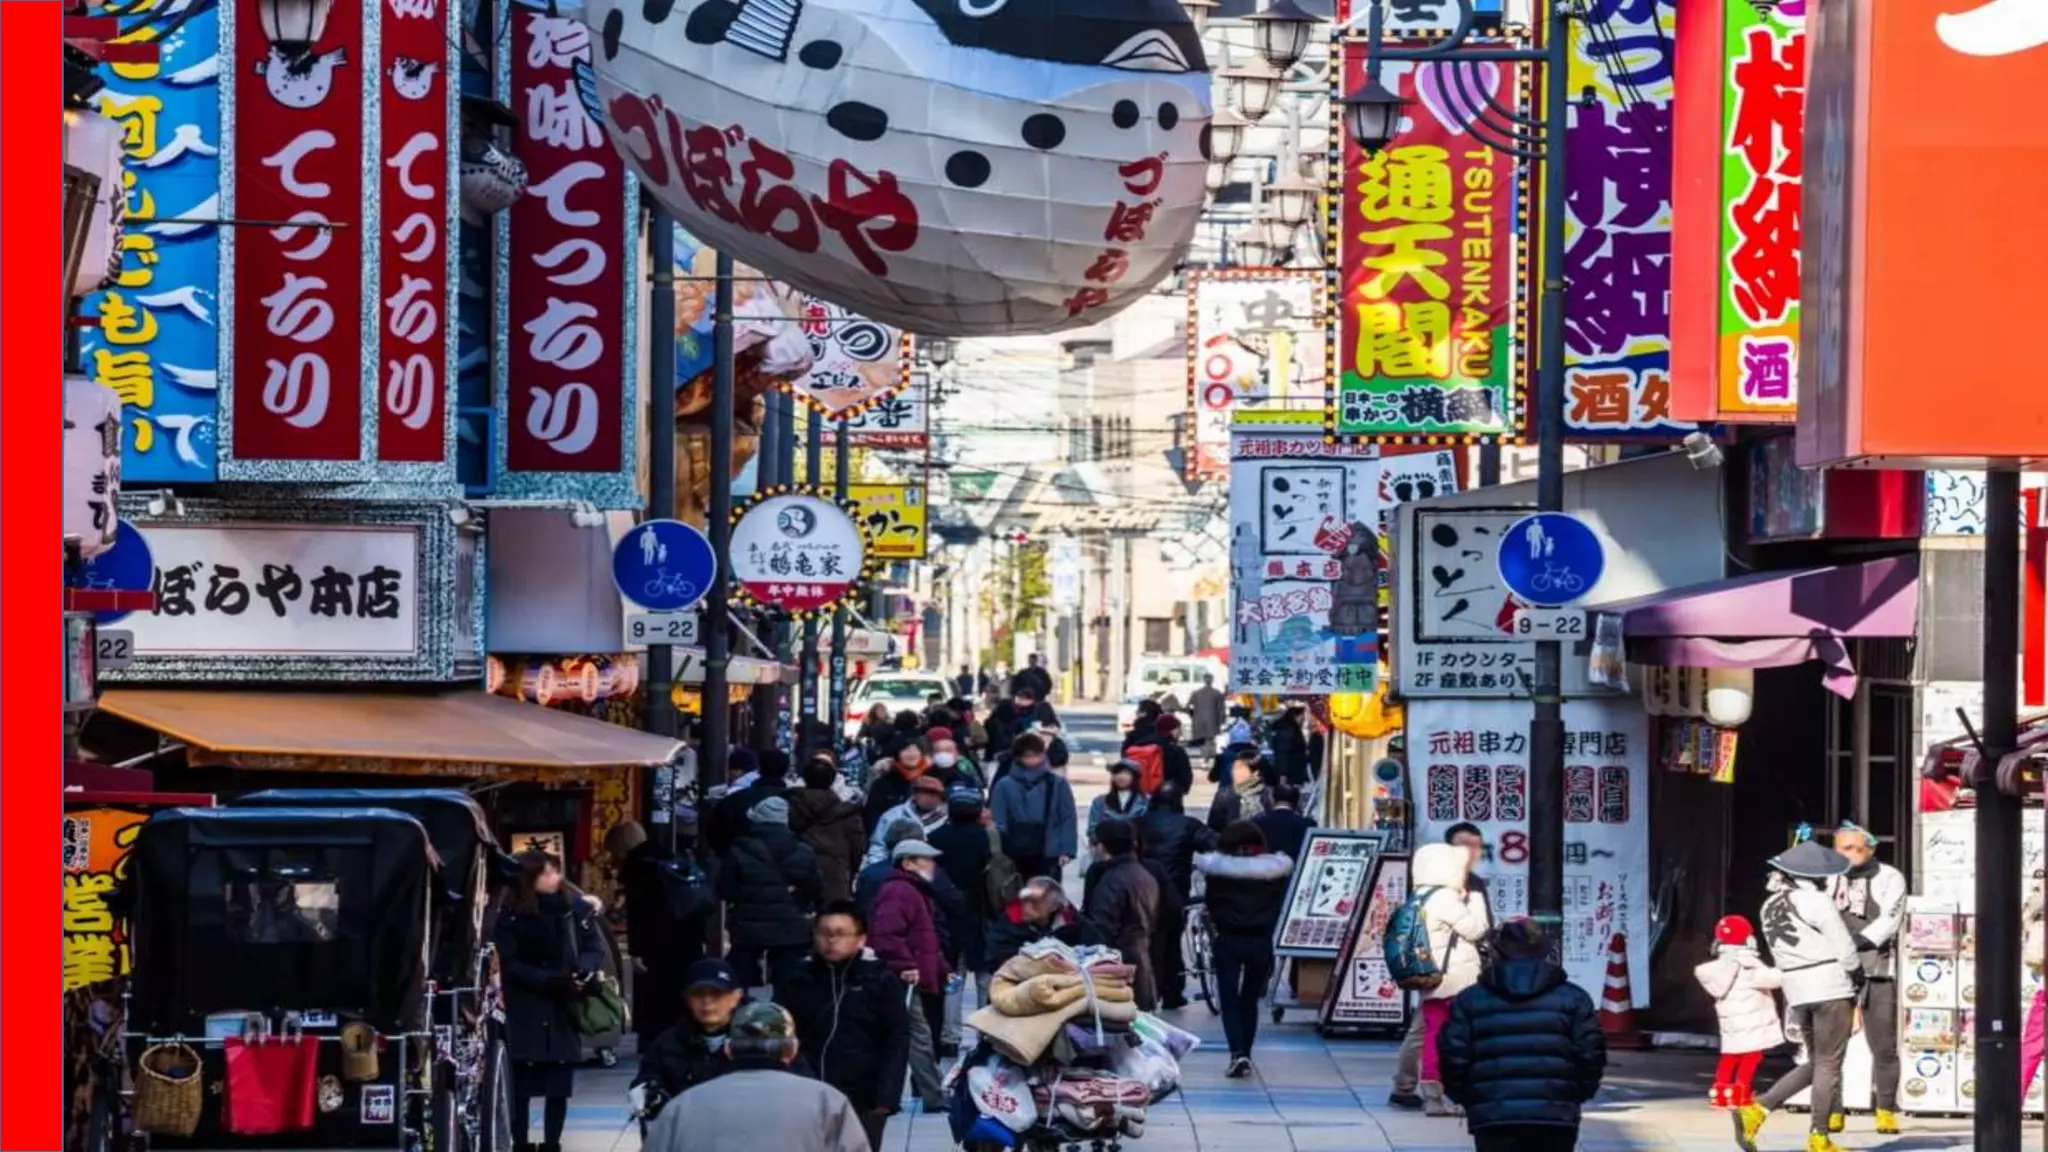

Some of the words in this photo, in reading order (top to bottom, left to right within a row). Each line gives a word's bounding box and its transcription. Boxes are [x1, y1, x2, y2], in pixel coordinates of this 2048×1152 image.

[609, 93, 918, 276] づぼらや
[1061, 152, 1170, 318] づぼらや
[1356, 145, 1454, 379] 通天閣
[1460, 145, 1494, 379] TSUTENKAKU
[262, 129, 337, 428] てっちり
[387, 131, 439, 430] てっちり
[99, 638, 130, 660] 22
[1414, 673, 1434, 687] 2F
[1416, 652, 1435, 665] 1F
[1440, 652, 1535, 668] カウンター
